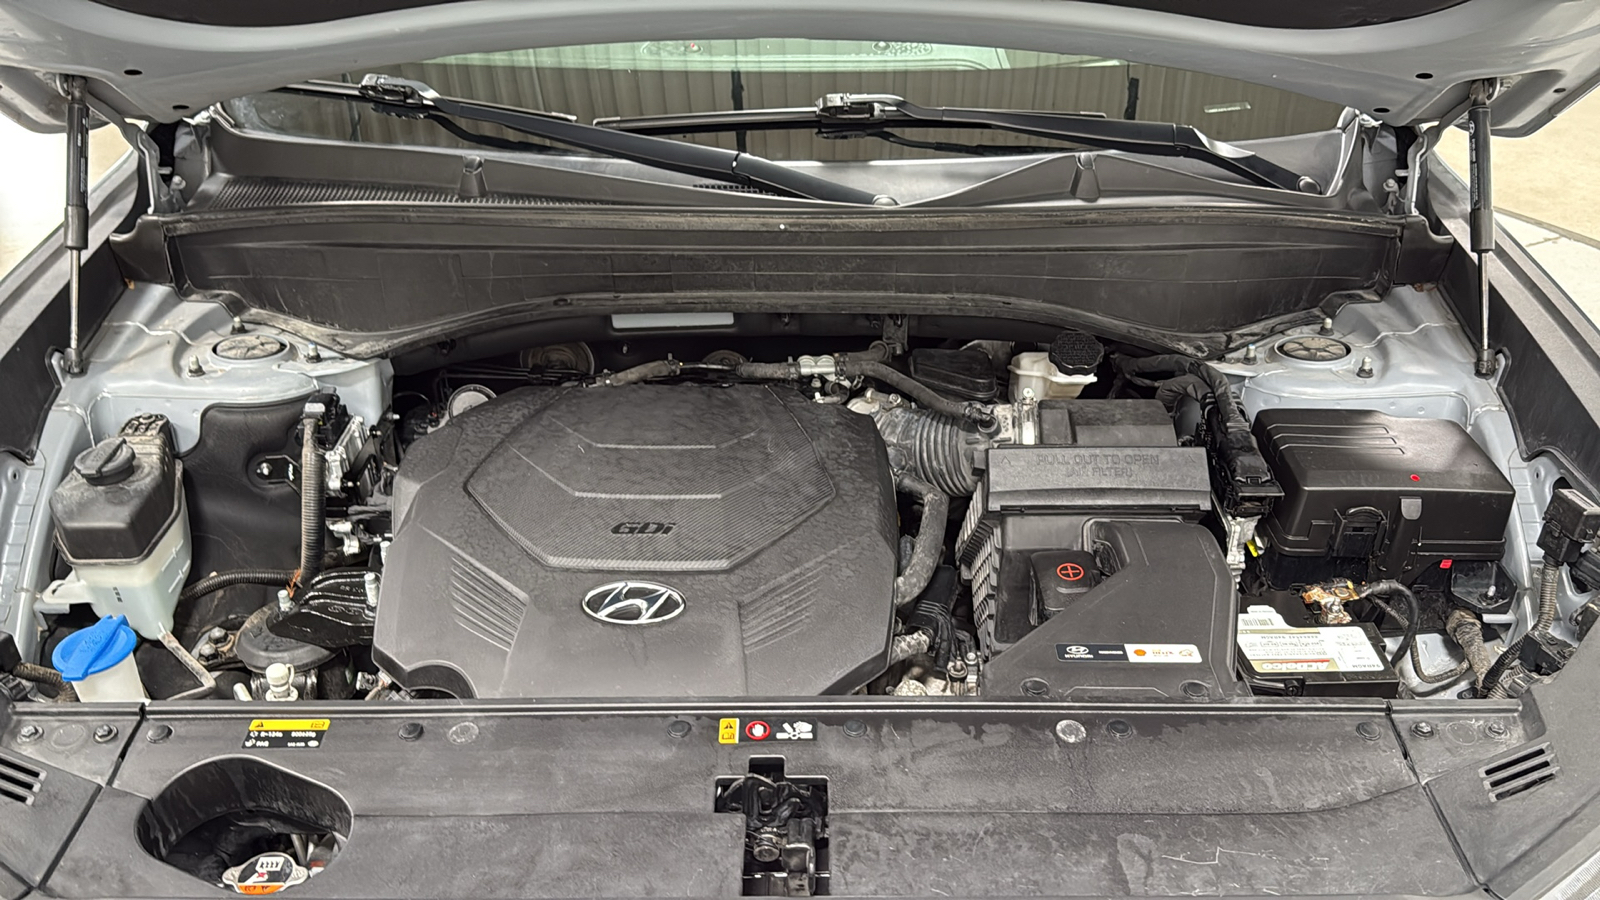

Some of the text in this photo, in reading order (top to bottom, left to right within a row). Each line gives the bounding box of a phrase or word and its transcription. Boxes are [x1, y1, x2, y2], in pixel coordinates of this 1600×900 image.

[1037, 454, 1160, 466] PULL OUT TO OPEN
[611, 522, 676, 535] GDi
[1262, 661, 1329, 671] ACDelco
